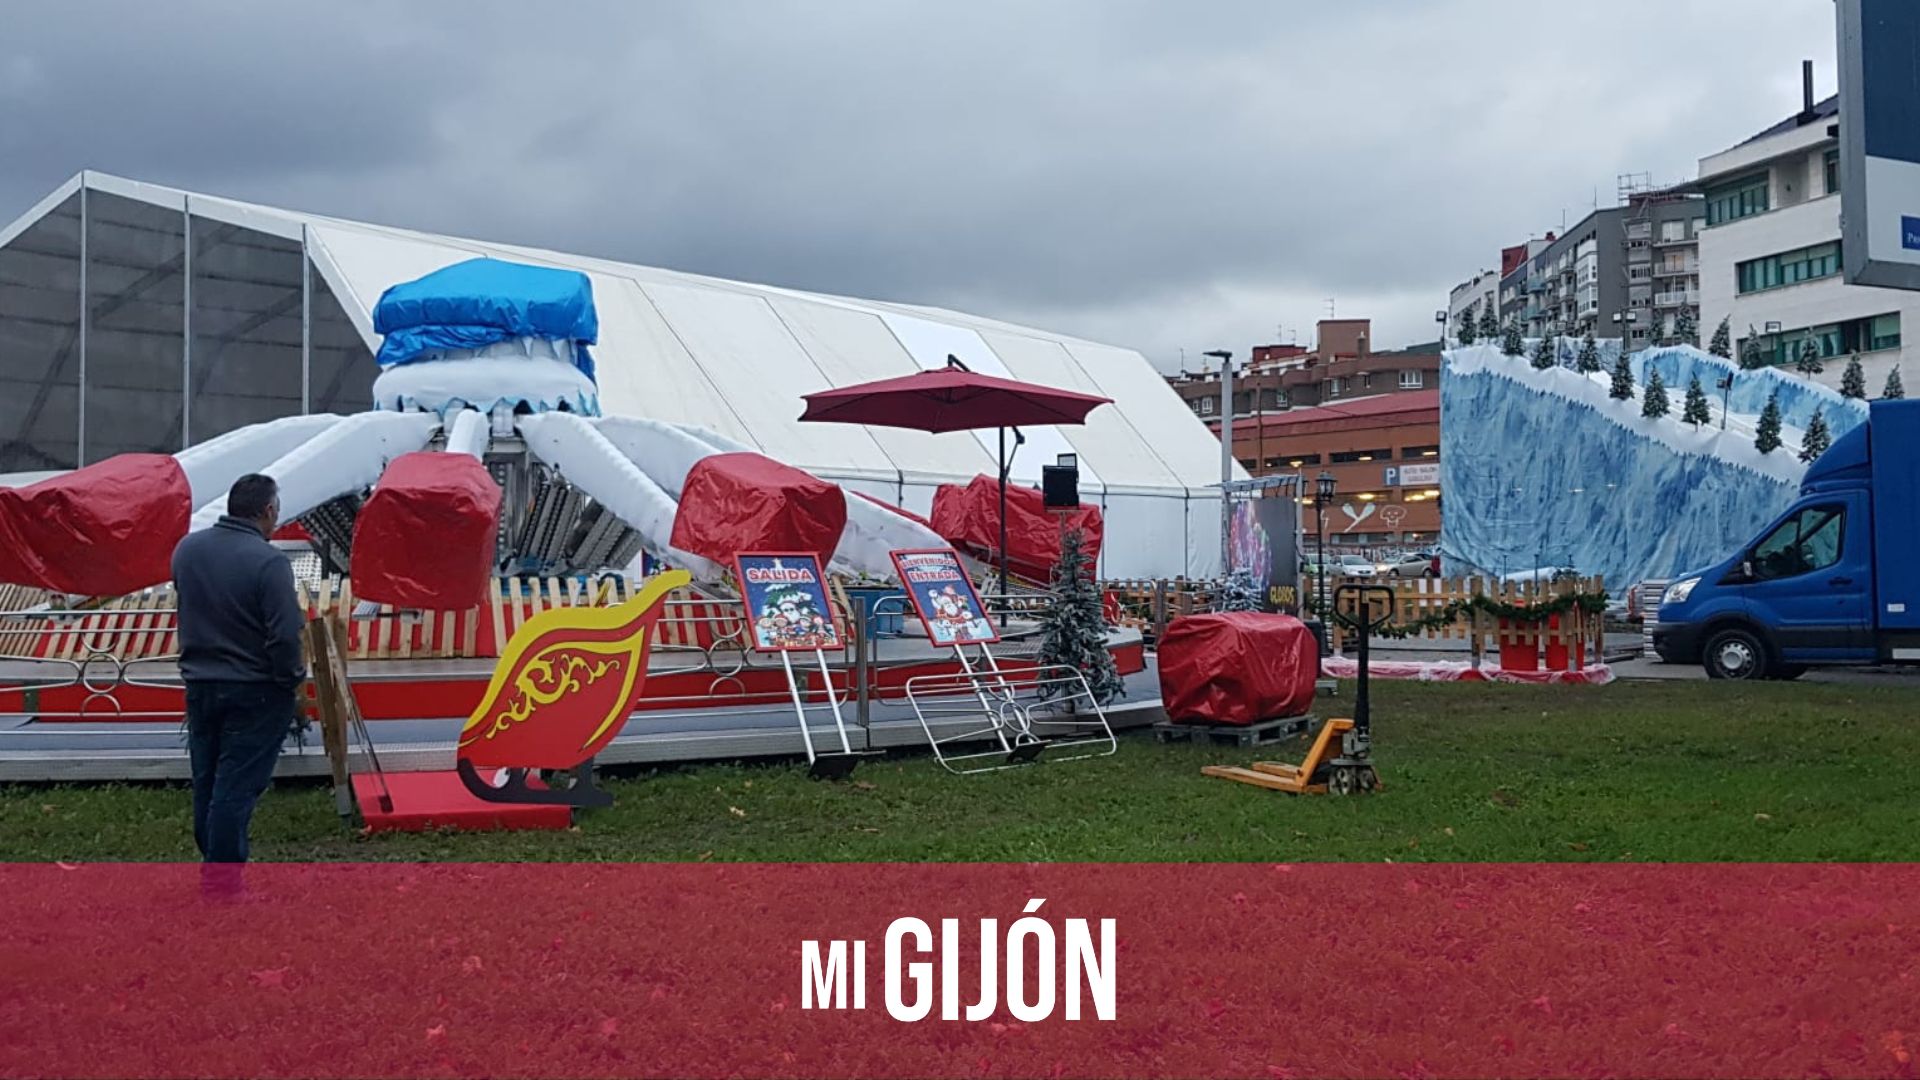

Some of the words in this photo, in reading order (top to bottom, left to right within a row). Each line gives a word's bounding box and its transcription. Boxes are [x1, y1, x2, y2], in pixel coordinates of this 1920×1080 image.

[1386, 467, 1396, 486] P
[747, 568, 815, 583] SALIDA
[908, 570, 961, 582] ENTRADA
